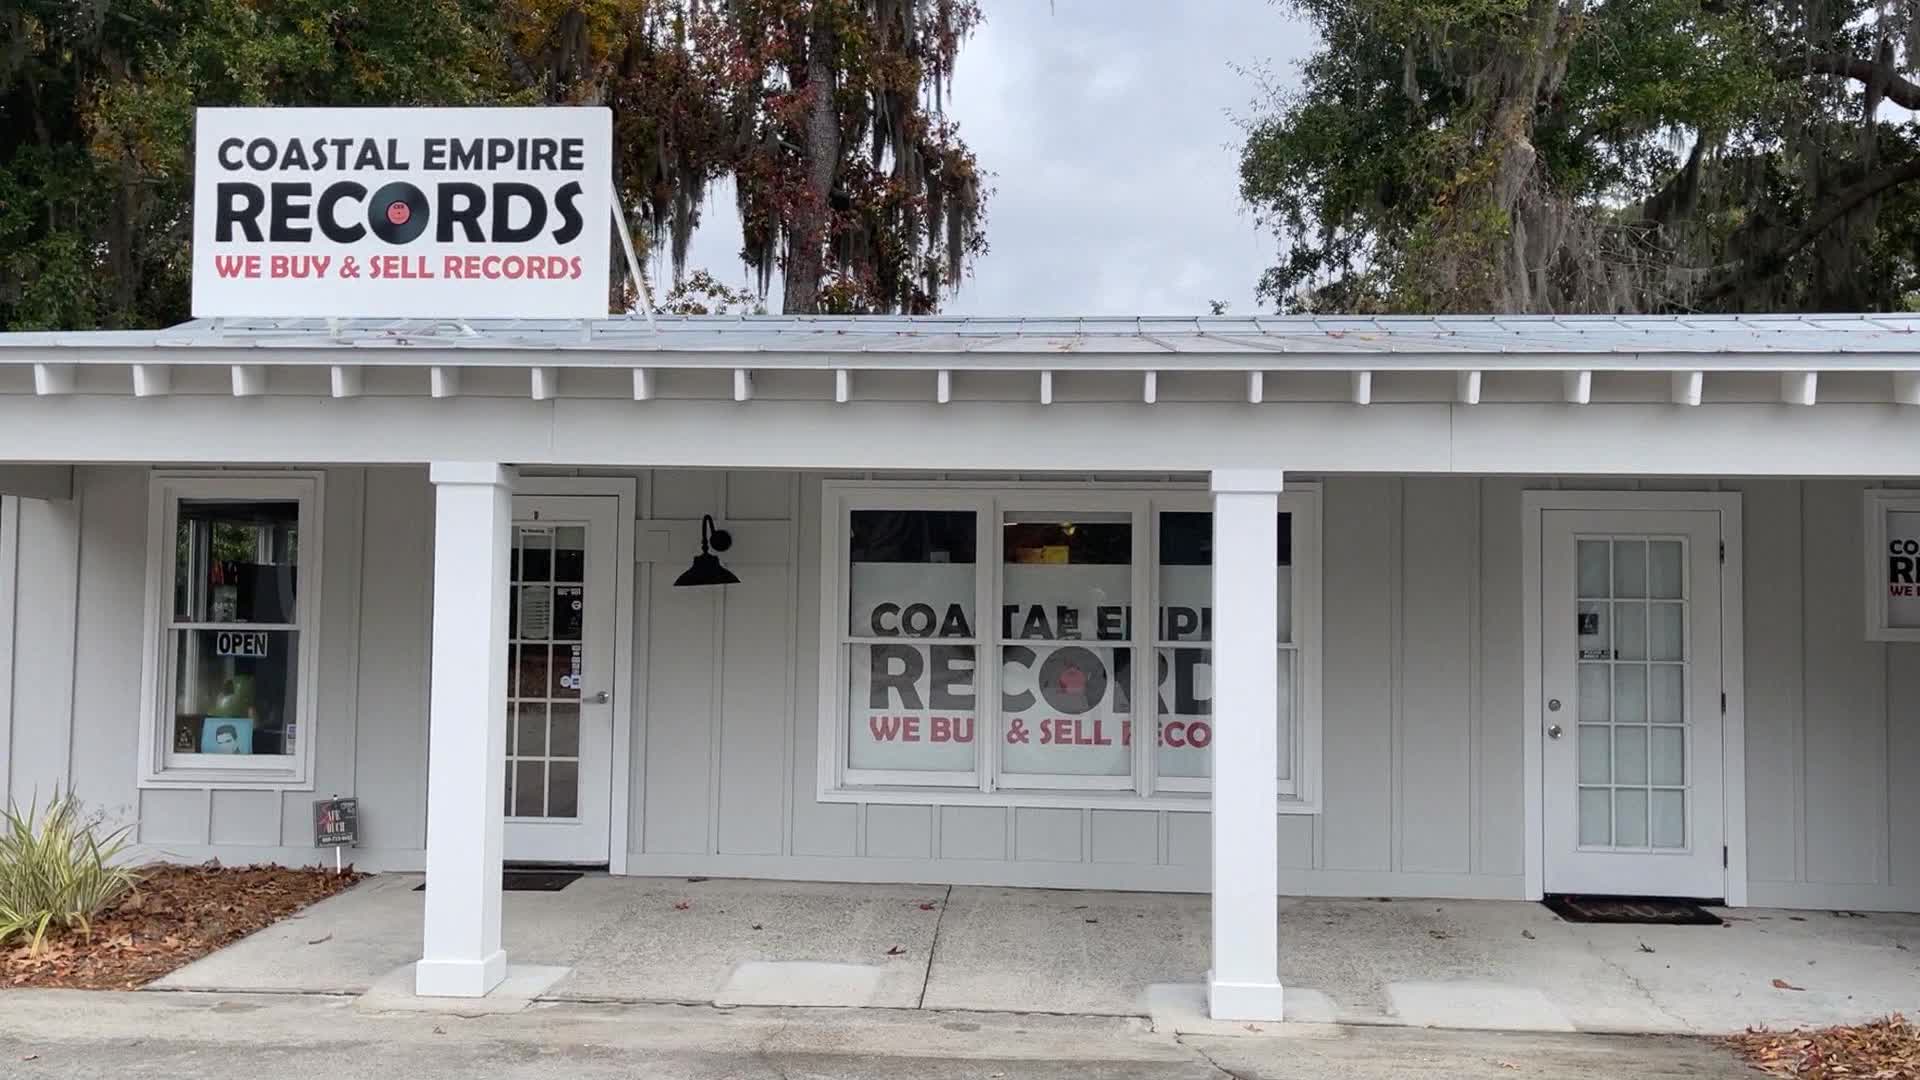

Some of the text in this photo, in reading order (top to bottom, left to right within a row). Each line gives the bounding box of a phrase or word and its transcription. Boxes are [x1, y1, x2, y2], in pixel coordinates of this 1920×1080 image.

[218, 138, 584, 170] COASTAL EMPIRE
[215, 181, 583, 245] RECORDS
[215, 255, 582, 280] WE BUY & SELL RECORDS
[1889, 540, 1920, 555] CO
[1890, 585, 1913, 597] WE
[871, 602, 1082, 640] COATAL
[219, 632, 266, 655] OPEN
[869, 643, 1213, 715] RECORD
[869, 716, 920, 741] WE
[930, 717, 975, 742] BU
[1007, 718, 1030, 744] &
[1039, 719, 1112, 745] SELL
